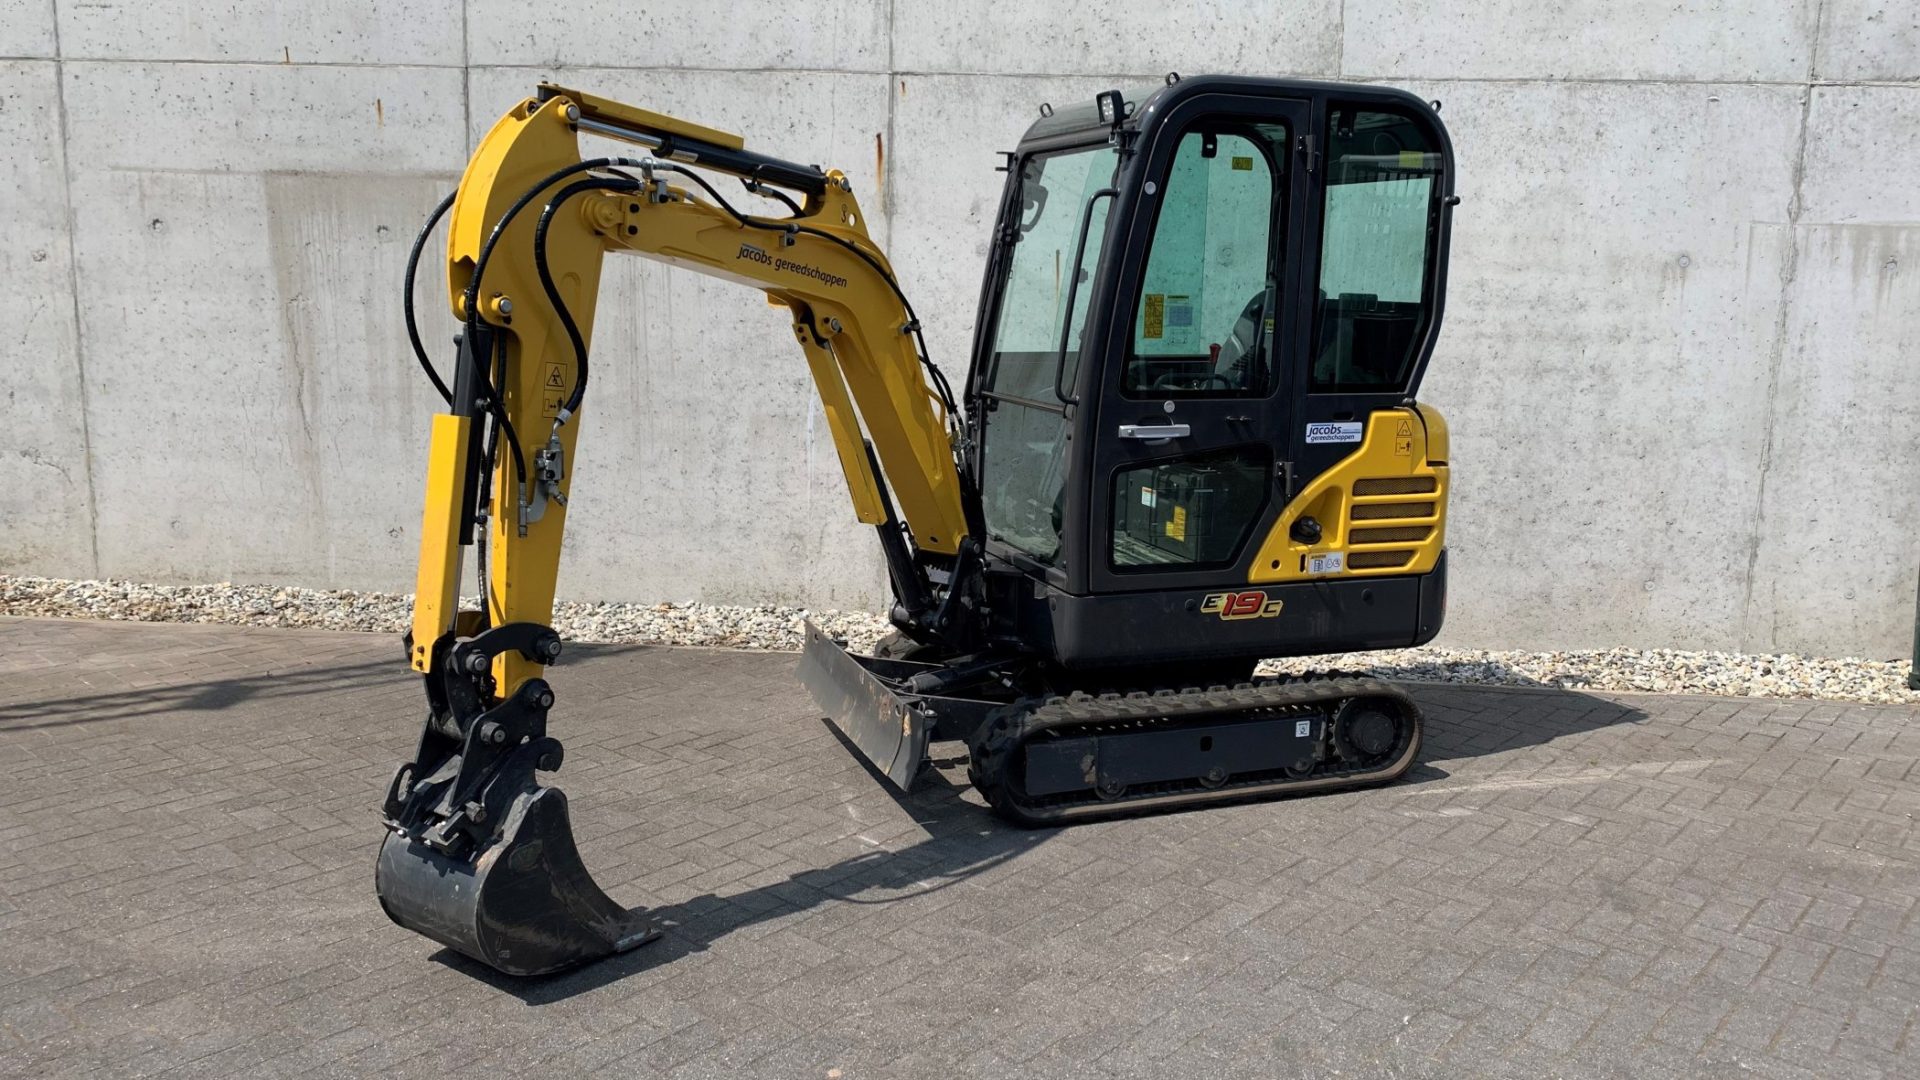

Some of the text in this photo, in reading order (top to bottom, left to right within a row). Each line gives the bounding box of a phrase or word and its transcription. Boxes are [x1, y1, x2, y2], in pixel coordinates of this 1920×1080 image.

[736, 247, 848, 288] jacobs gereedschappen
[1307, 424, 1342, 437] jacobs
